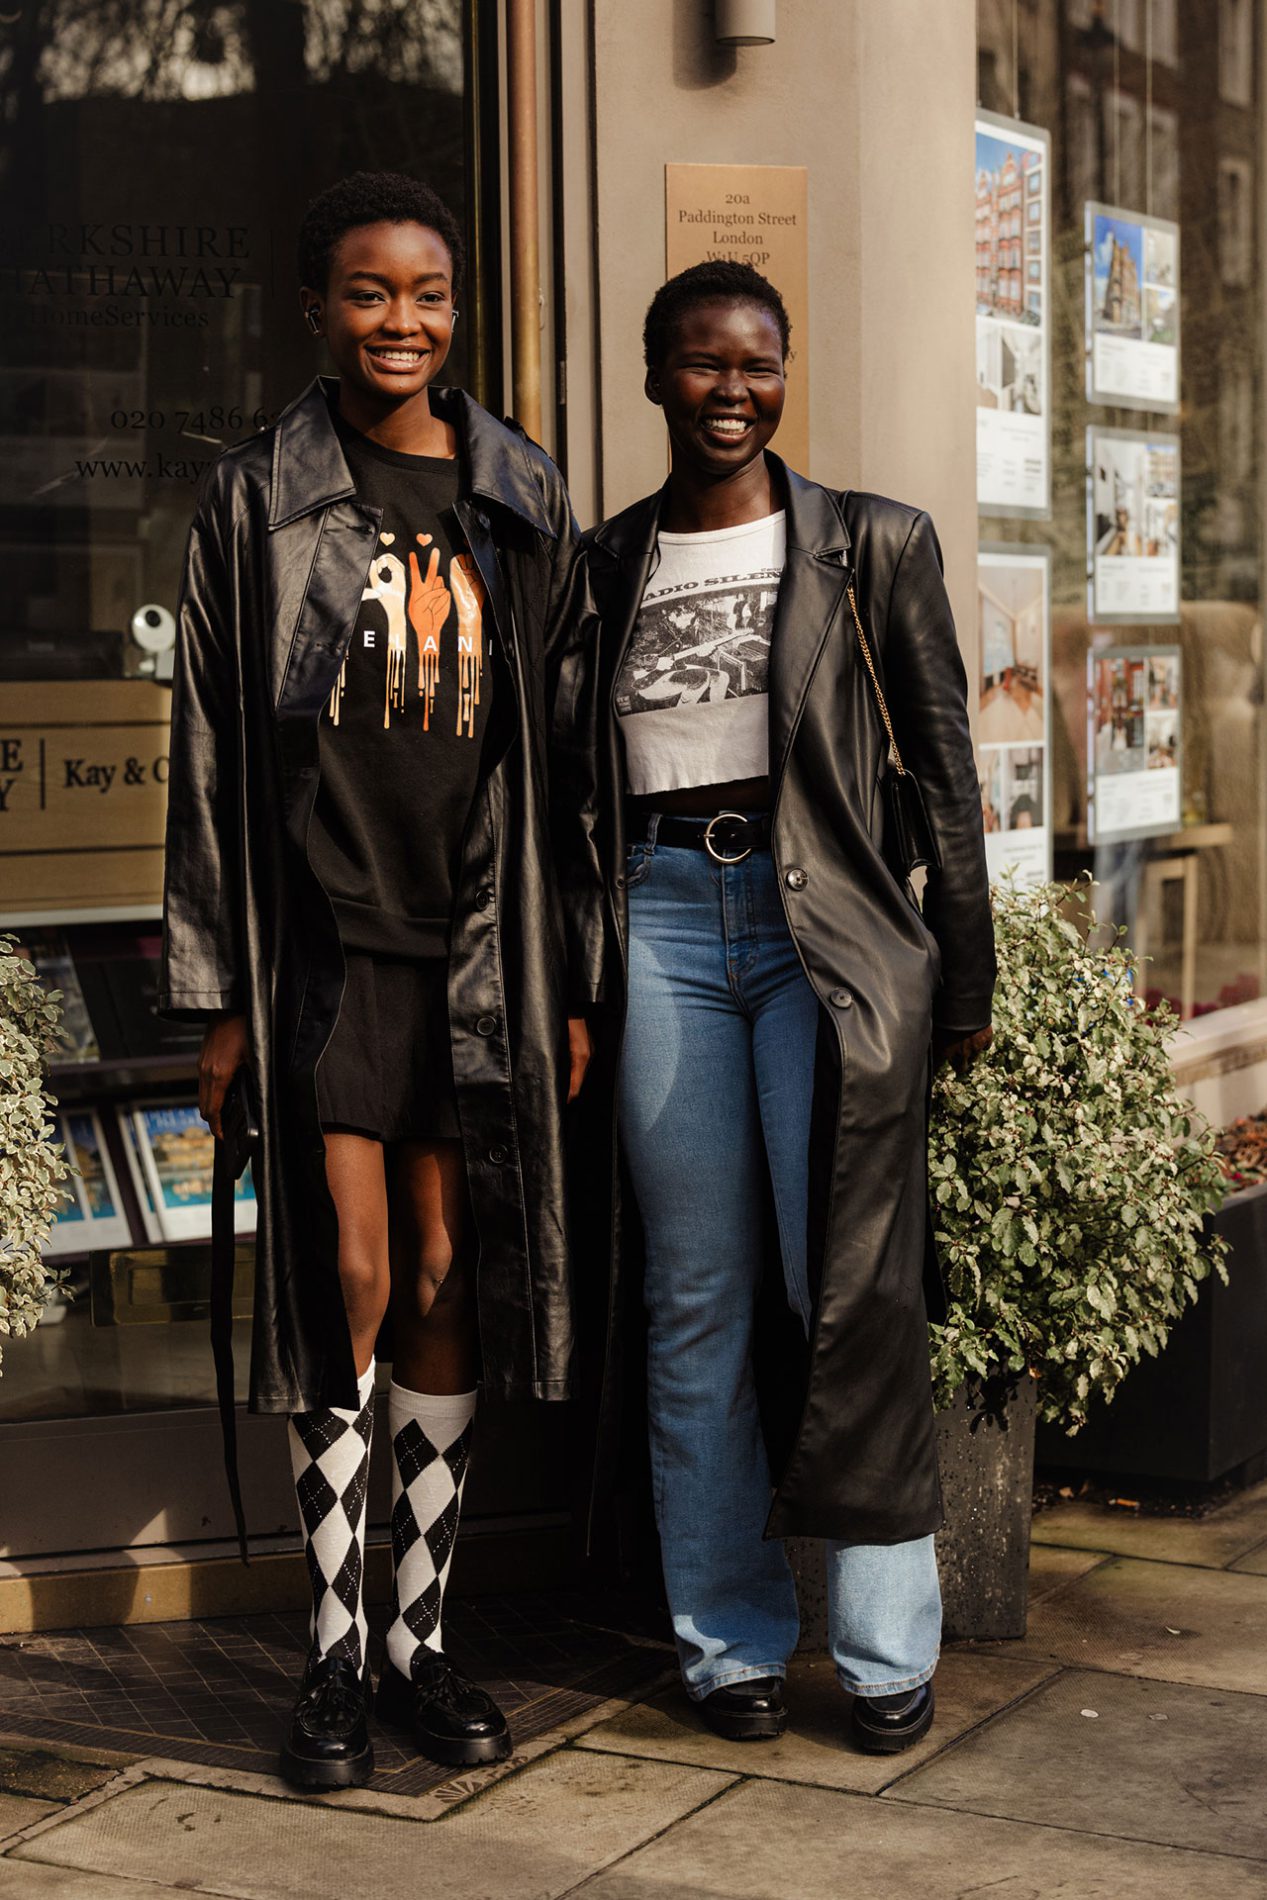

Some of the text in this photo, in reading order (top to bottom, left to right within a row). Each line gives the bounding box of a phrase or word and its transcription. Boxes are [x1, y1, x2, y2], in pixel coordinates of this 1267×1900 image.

[725, 194, 751, 205] 20a
[679, 210, 797, 228] Paddington Street
[0, 223, 250, 258] RKSHIRE
[713, 231, 764, 245] London
[110, 410, 165, 430] 020
[174, 405, 243, 435] 7486
[75, 453, 215, 485] www.kay
[642, 571, 783, 601] ADIO SILEN
[362, 630, 493, 656] ELANI
[64, 755, 169, 793] Kay & C
